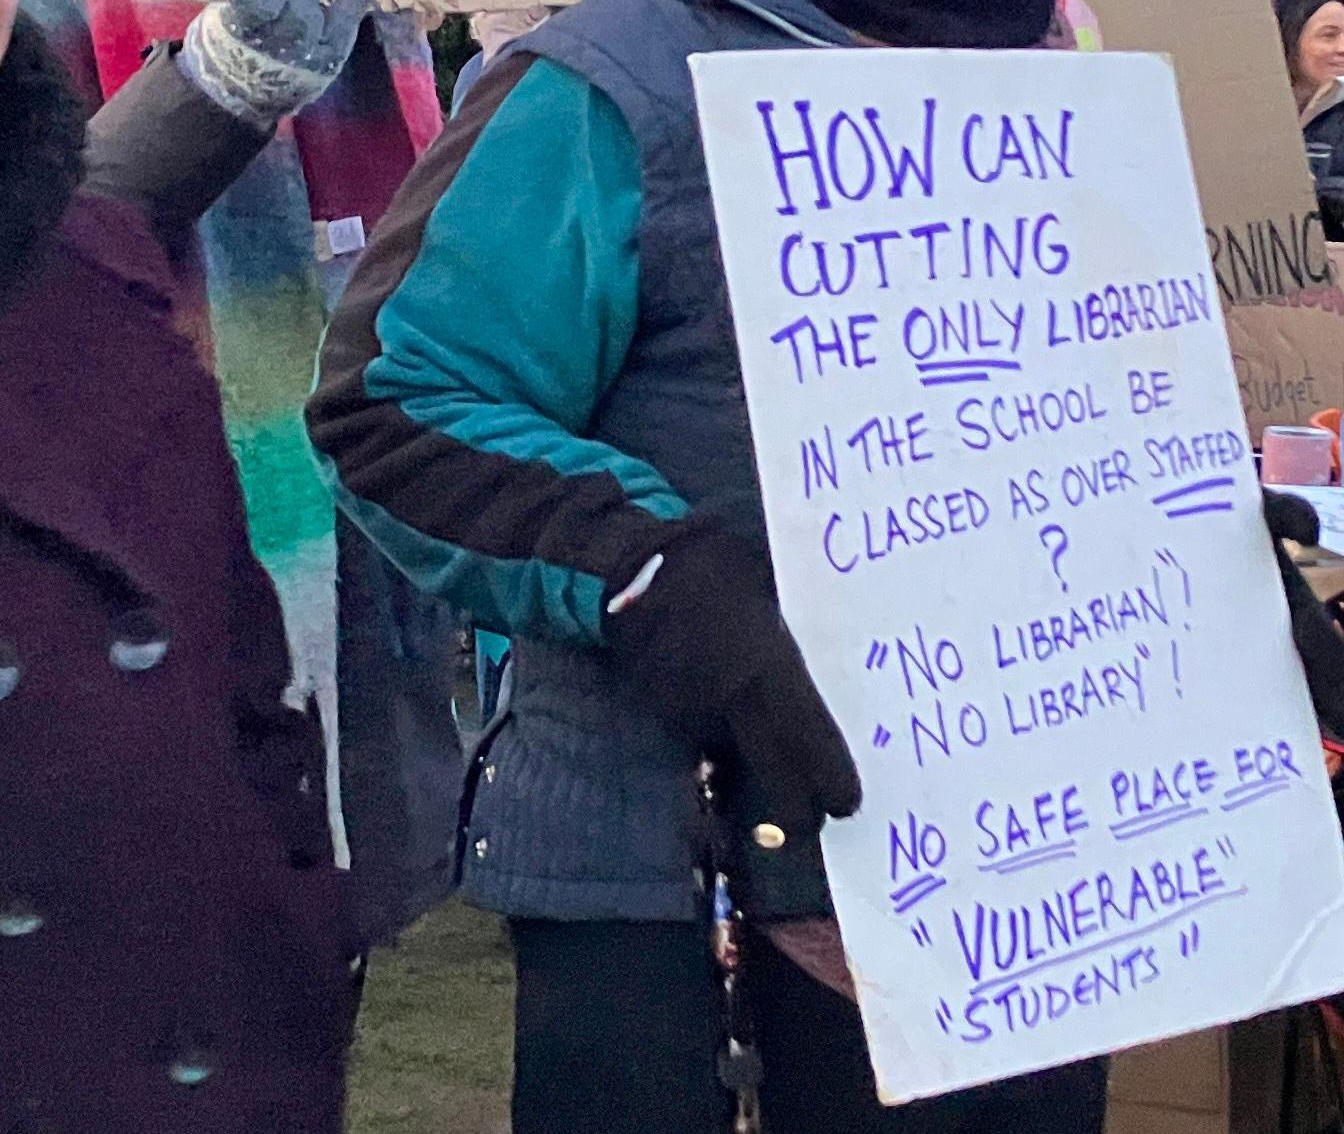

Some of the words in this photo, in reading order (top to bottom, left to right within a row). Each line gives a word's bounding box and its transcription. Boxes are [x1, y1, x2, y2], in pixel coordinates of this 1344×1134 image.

[756, 98, 937, 215] HOW
[962, 110, 1076, 182] CAN
[780, 214, 1070, 297] CUTTING
[770, 313, 880, 384] THE
[902, 299, 1025, 362] ONLY
[1047, 272, 1211, 349] LIBRARIAN
[799, 426, 839, 498] IN
[846, 413, 934, 477] THE
[956, 382, 1107, 451] SCHOOL
[1128, 369, 1174, 414] BE
[823, 489, 990, 572] CLASSED
[1010, 469, 1050, 520] AS
[1061, 448, 1138, 507] OVER
[1143, 429, 1245, 482] STAFFED
[887, 812, 947, 878] NO
[977, 785, 1090, 859] SAFE
[1110, 757, 1218, 818] PLACE
[1233, 740, 1302, 787] FOR
